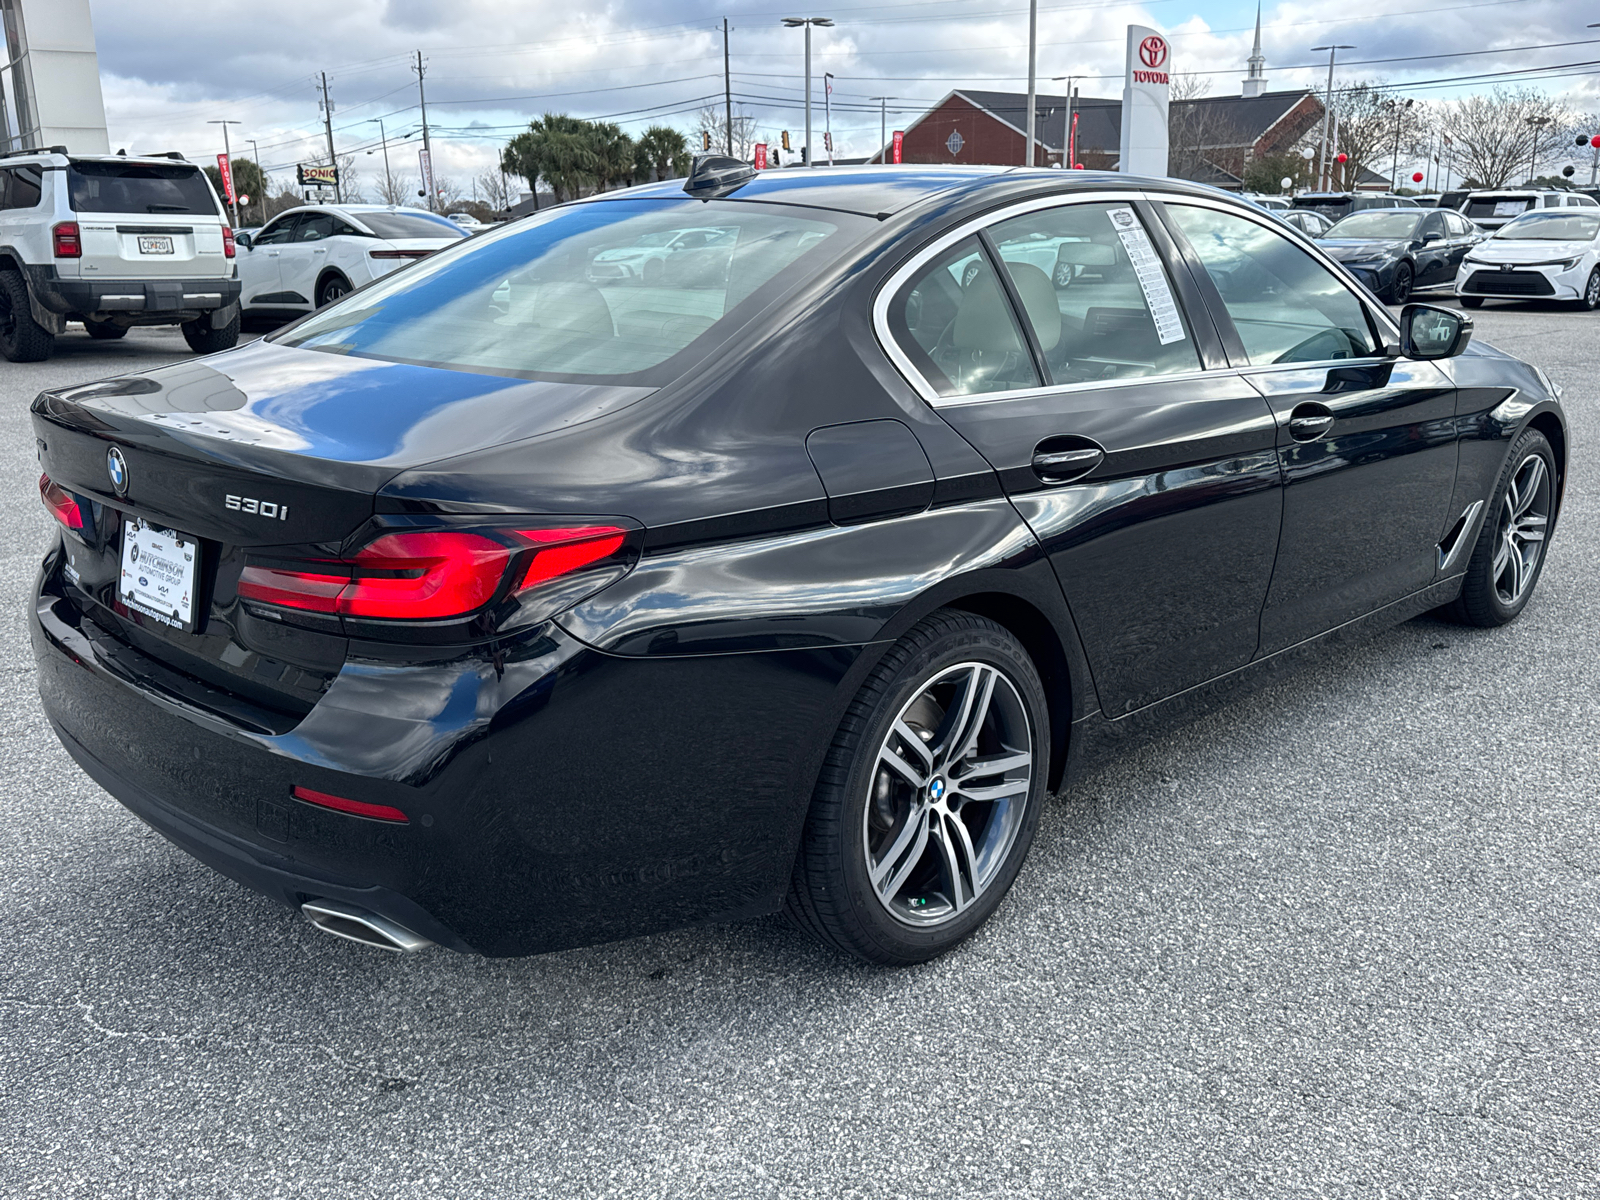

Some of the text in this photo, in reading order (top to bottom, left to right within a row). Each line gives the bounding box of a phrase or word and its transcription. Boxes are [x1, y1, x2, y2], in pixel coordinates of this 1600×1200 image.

[1133, 70, 1169, 85] TOYOTA
[222, 164, 233, 202] TOYOT
[304, 169, 335, 178] SONIC
[225, 494, 288, 521] 530i
[138, 564, 181, 587] AUTOMOTIVE GROUP
[139, 550, 185, 578] HUTCHINSON
